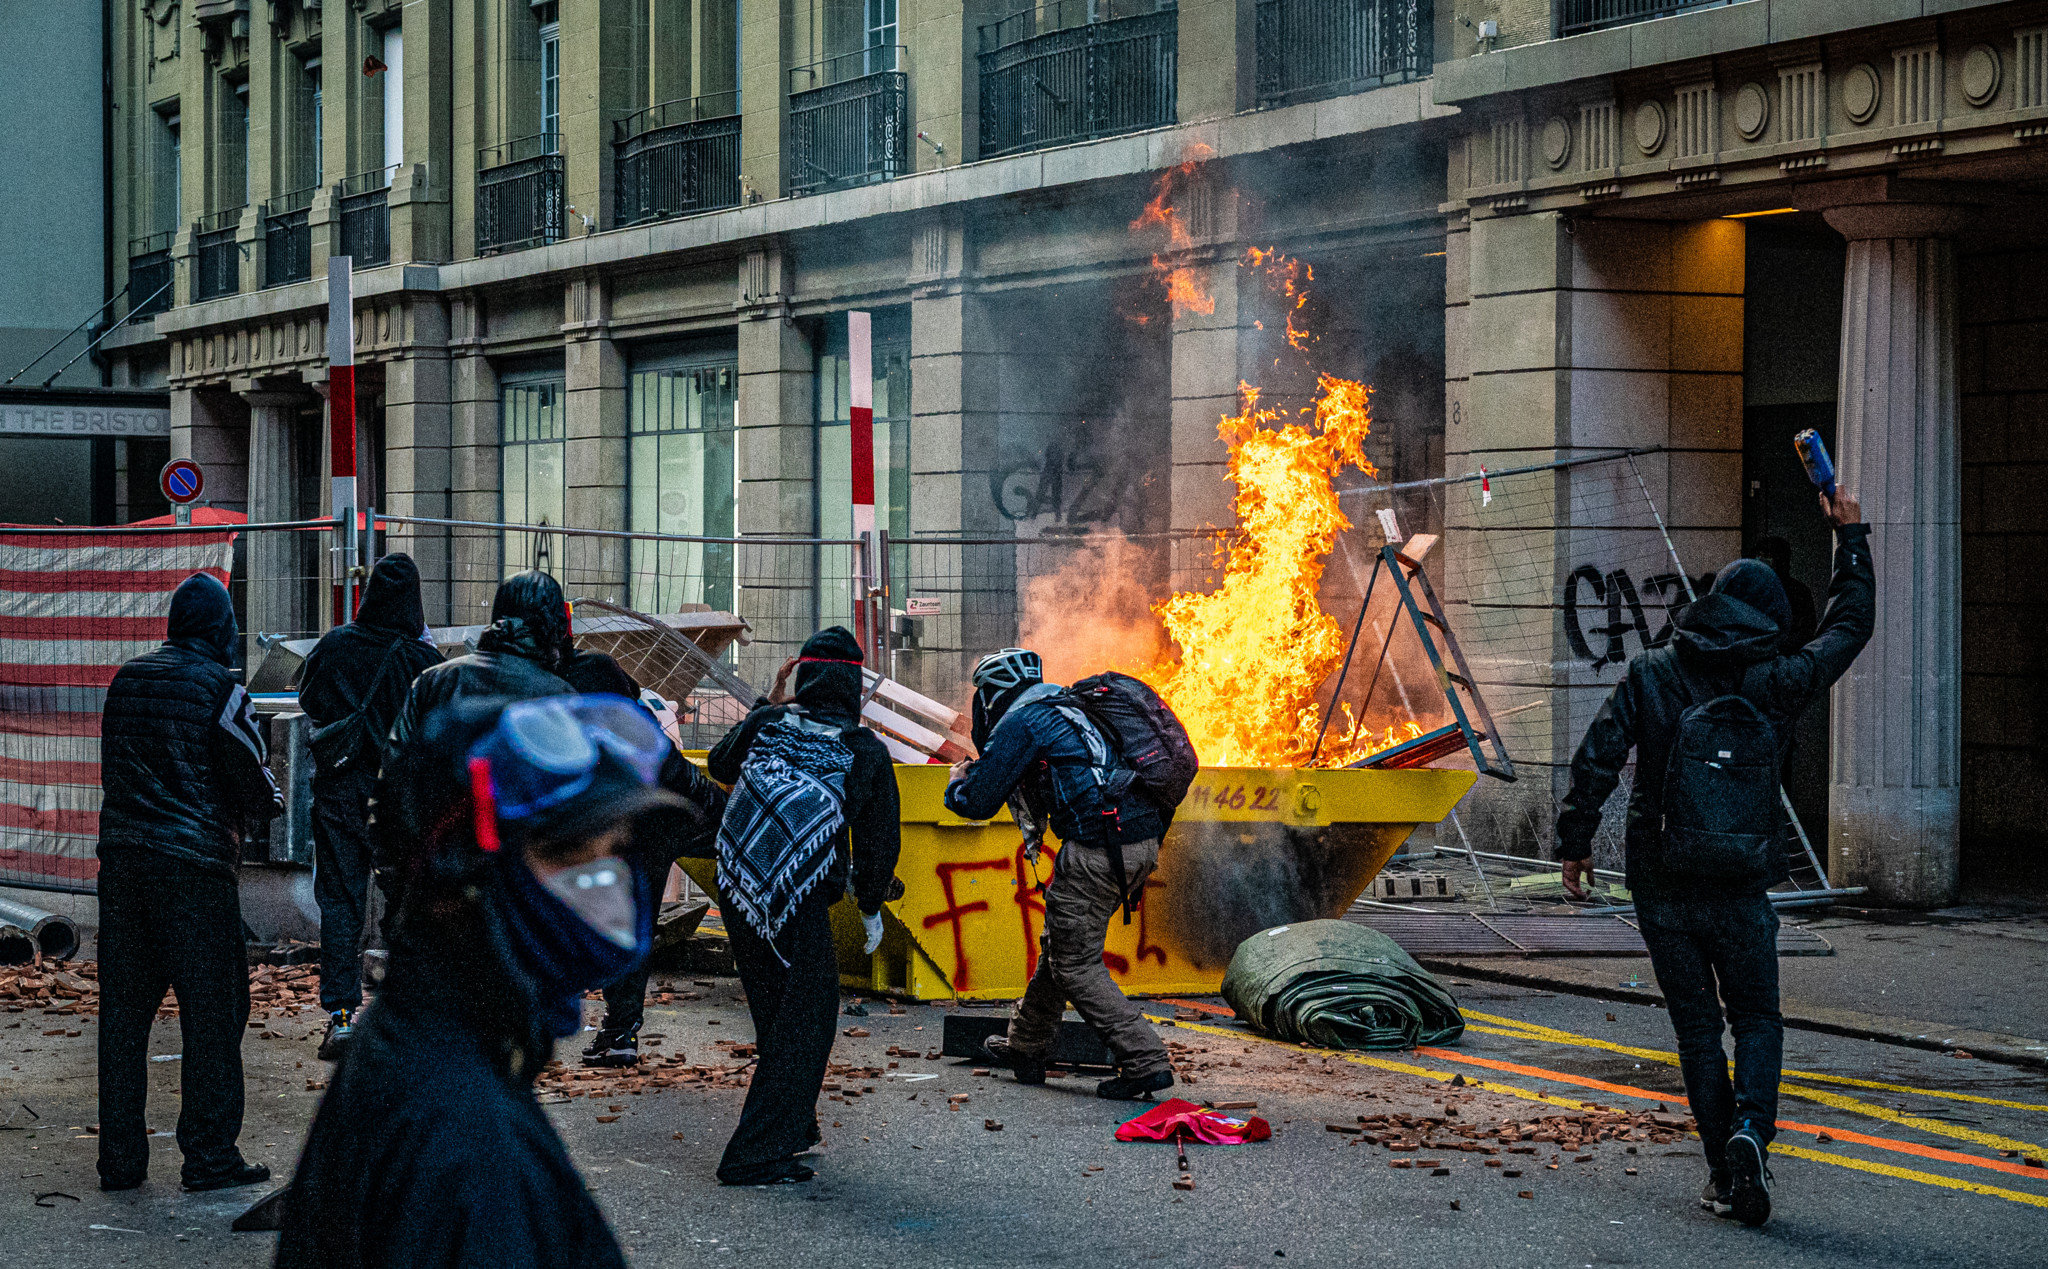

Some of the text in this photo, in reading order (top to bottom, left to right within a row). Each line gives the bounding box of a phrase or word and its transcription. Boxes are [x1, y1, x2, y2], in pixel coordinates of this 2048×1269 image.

[16, 410, 65, 430] THE
[1453, 401, 1461, 425] 8
[1564, 565, 1717, 677] GAZ
